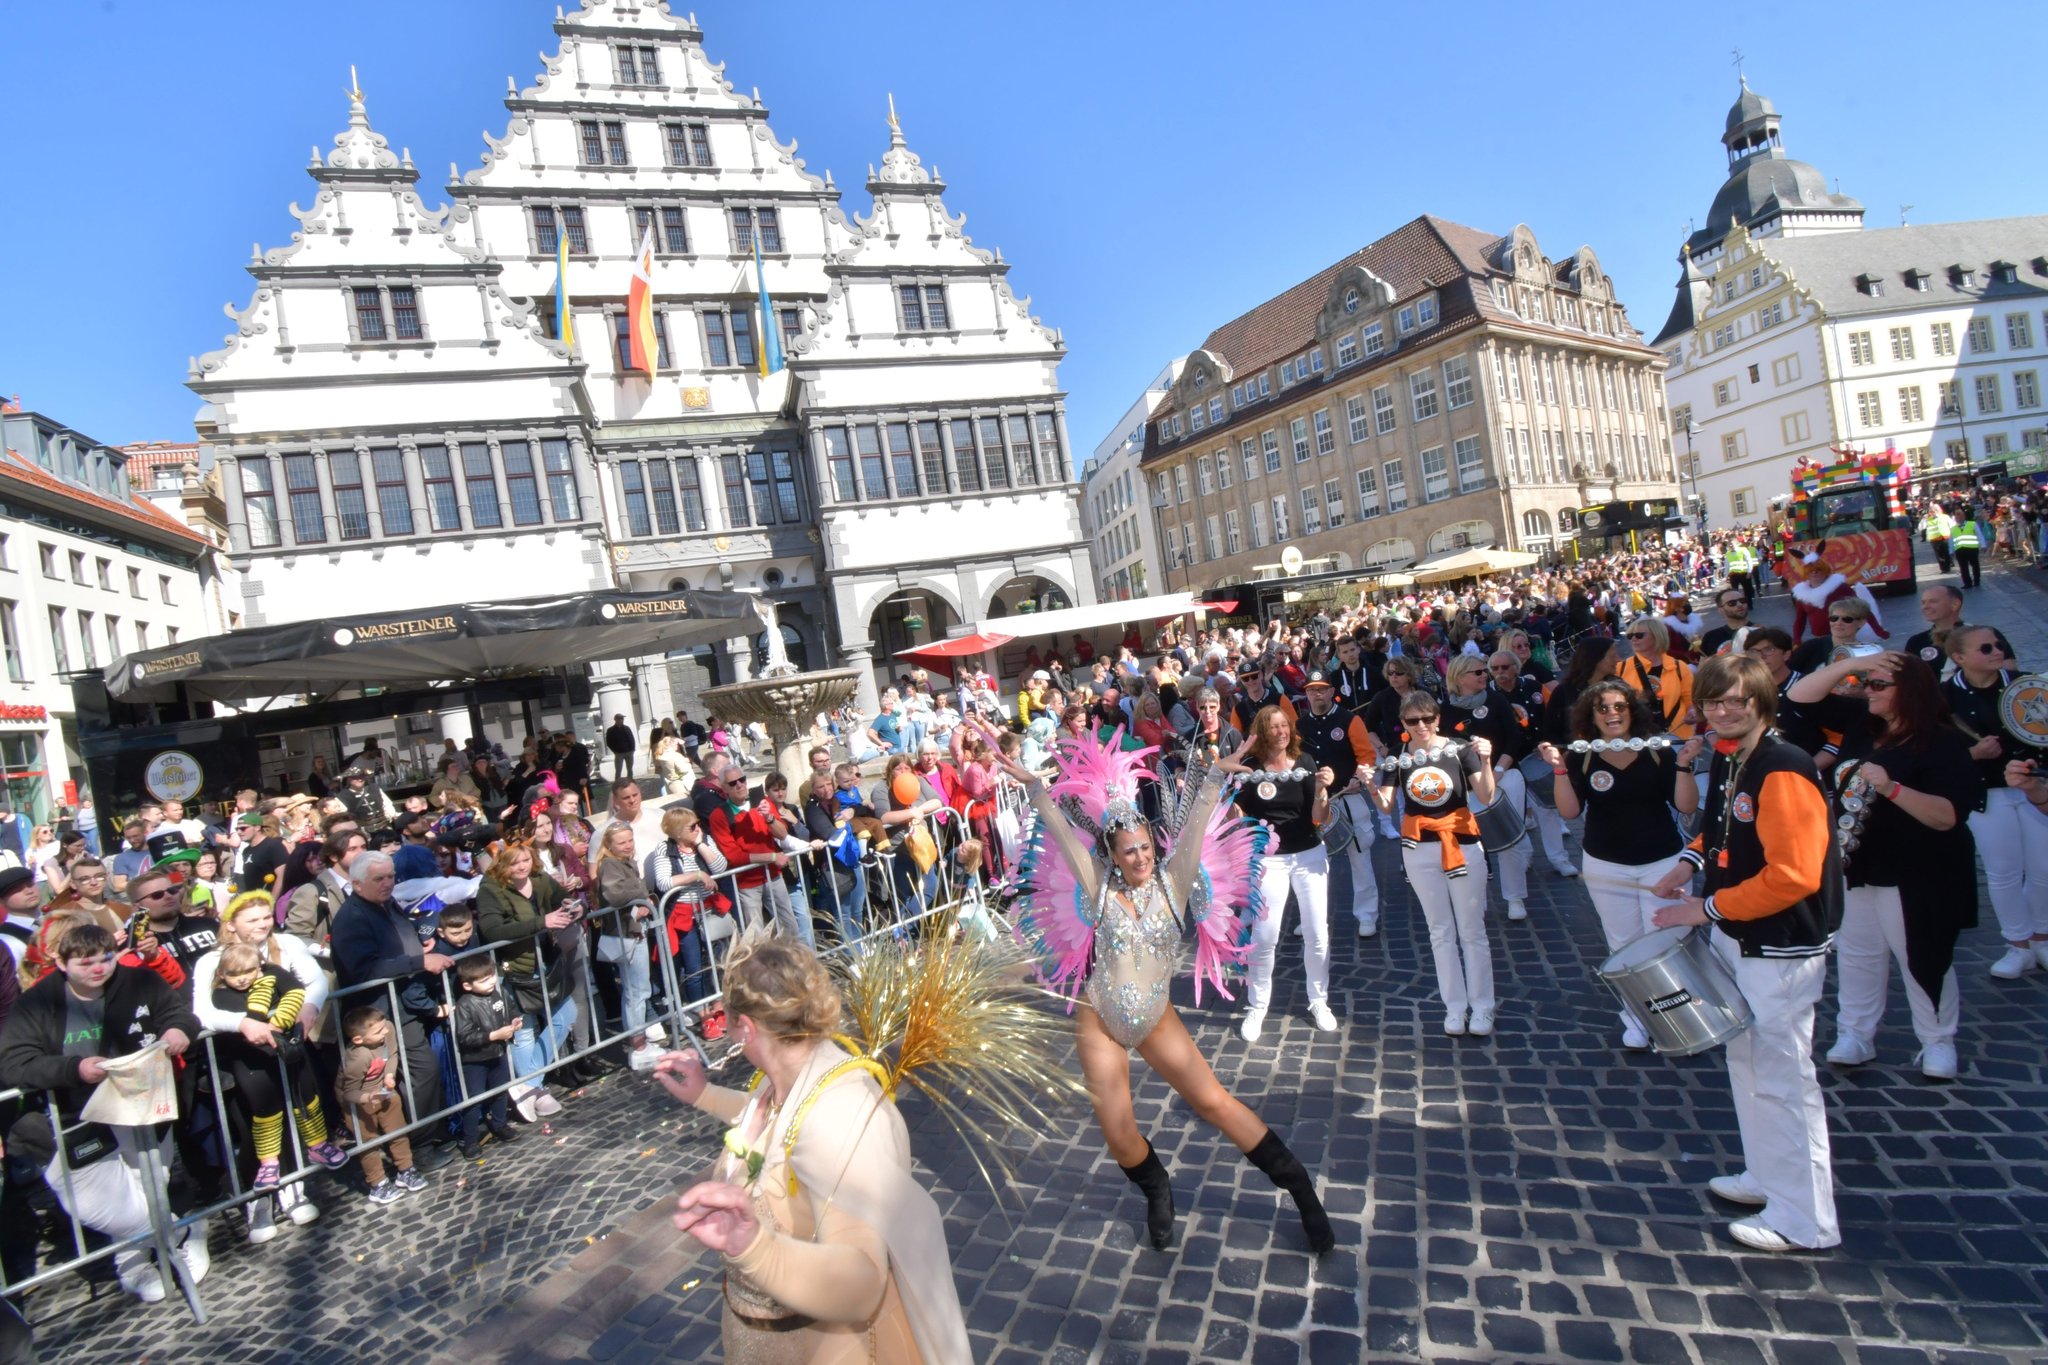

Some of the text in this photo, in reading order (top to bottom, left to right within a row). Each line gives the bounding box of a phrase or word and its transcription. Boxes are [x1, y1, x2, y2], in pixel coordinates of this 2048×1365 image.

[616, 600, 686, 614] WARSTEINER
[354, 616, 456, 638] WARSTEINER
[144, 652, 201, 673] WARSTEINER
